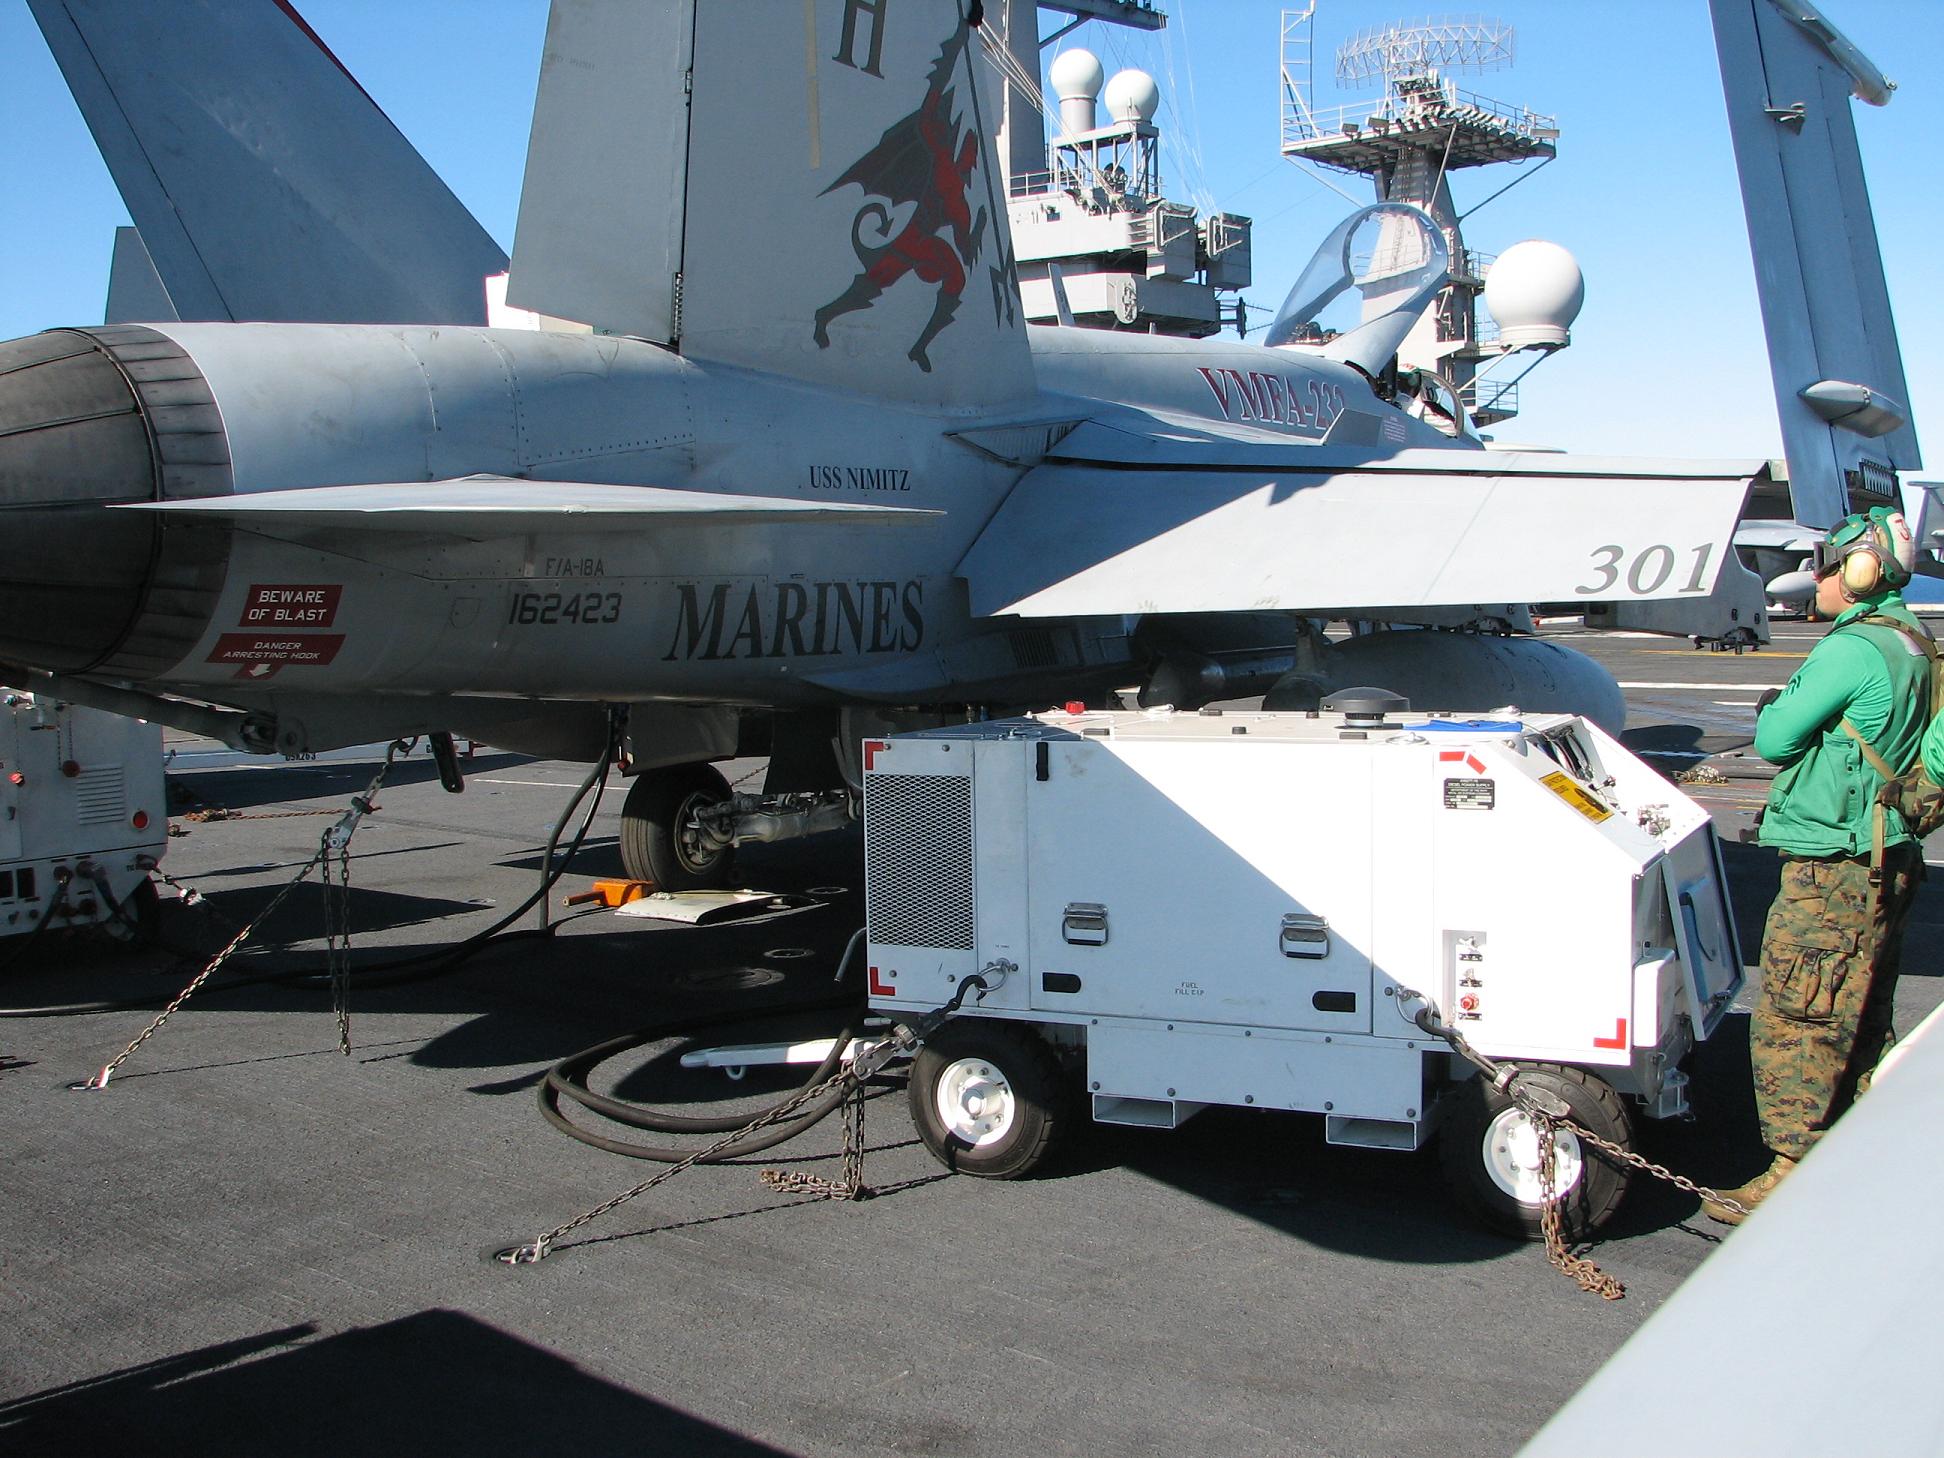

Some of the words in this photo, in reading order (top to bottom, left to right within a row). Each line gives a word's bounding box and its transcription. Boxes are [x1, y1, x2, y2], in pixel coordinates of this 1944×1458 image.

[809, 465, 842, 489] USS
[847, 467, 911, 491] NIMITZ
[545, 558, 605, 577] F/A-18A
[1574, 542, 1714, 595] 301
[257, 590, 326, 604] BEWARE
[248, 608, 270, 620] OF
[274, 609, 327, 621] BLAST
[508, 592, 622, 625] 162423
[661, 580, 924, 661] MARINES
[254, 641, 302, 650] DANGER
[223, 651, 288, 659] ARRESTING
[290, 652, 321, 660] HOOK
